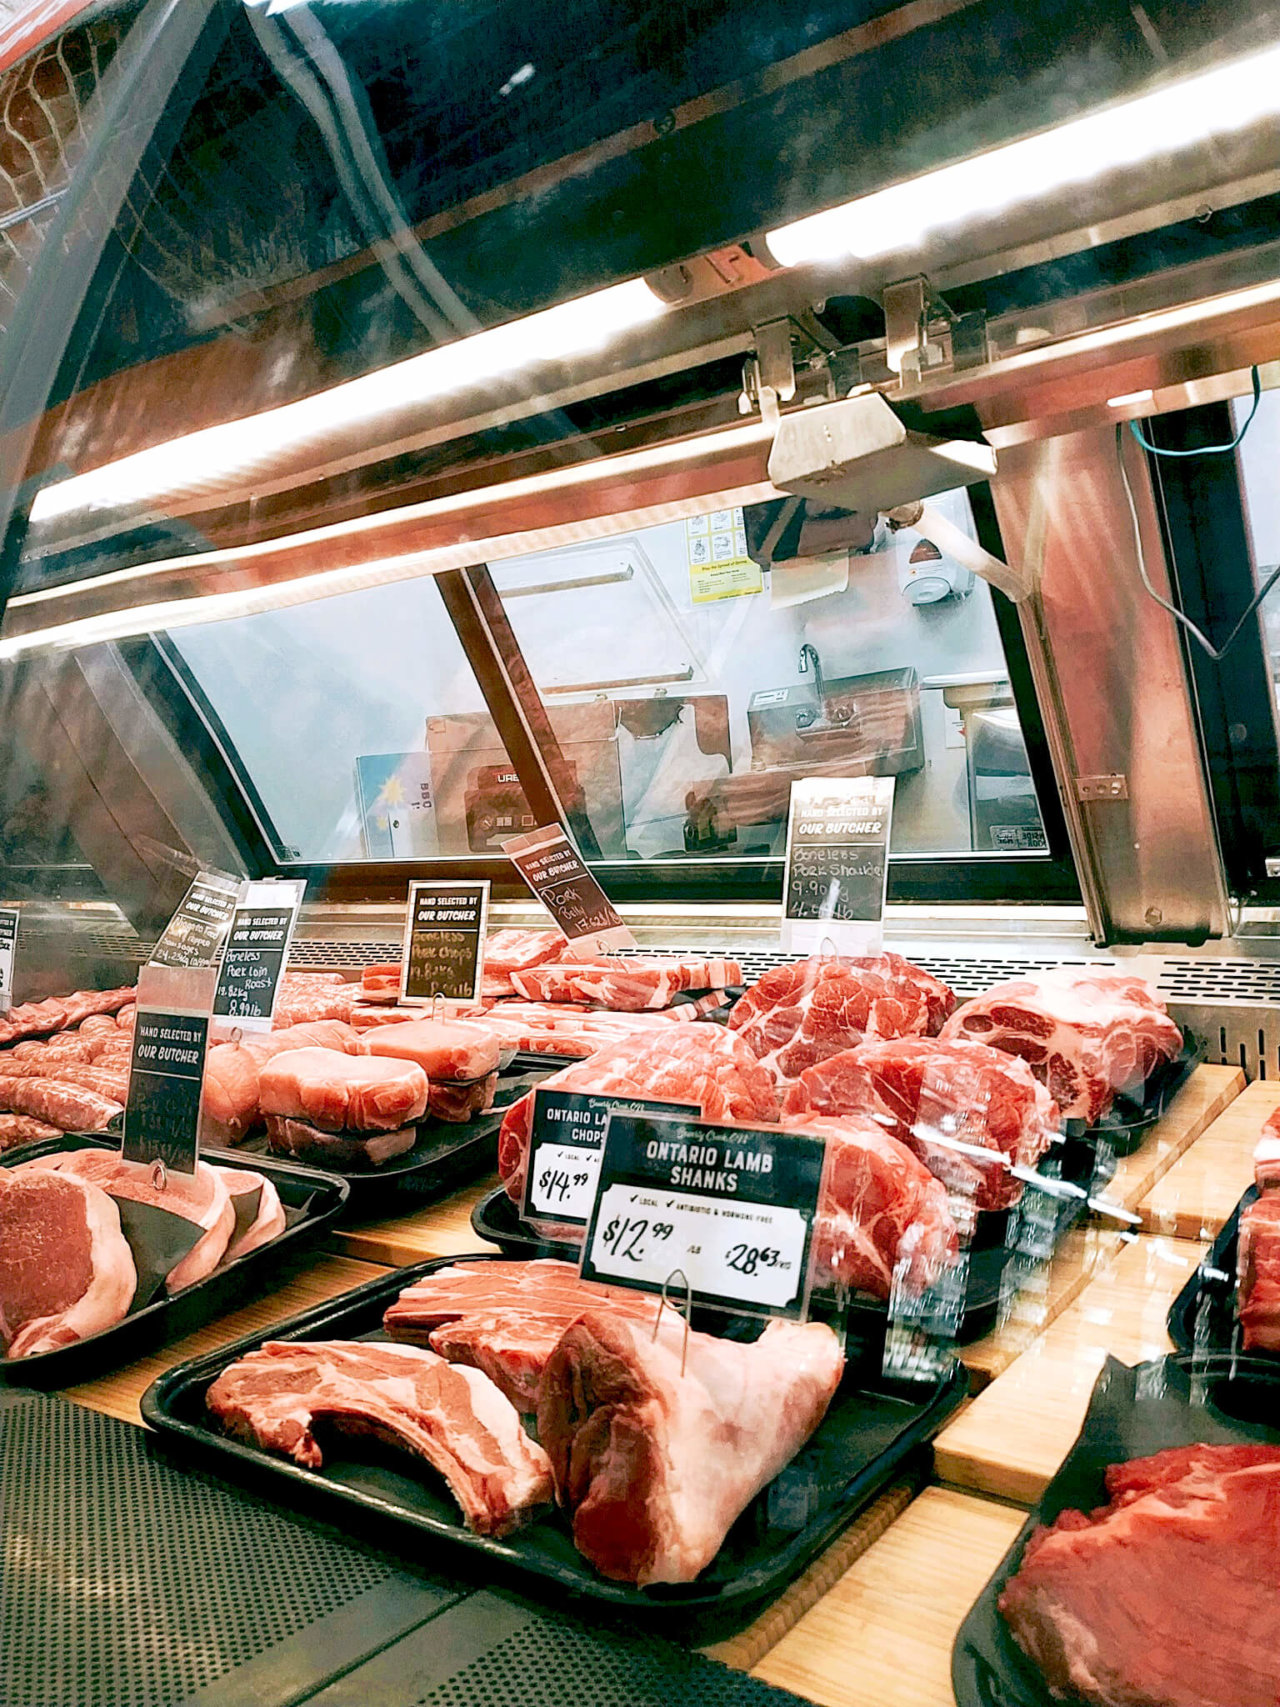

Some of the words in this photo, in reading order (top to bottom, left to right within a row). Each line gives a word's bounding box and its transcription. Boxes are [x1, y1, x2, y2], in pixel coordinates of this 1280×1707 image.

[799, 823, 824, 834] OUR
[825, 822, 882, 834] BUTCHER
[532, 871, 549, 882] OUR
[548, 860, 579, 877] BUTCHER
[420, 897, 436, 905] HAND
[437, 897, 468, 905] SELECTED
[469, 897, 478, 905] BY
[185, 901, 201, 912] OUR
[200, 905, 229, 920] BUTCHER
[418, 911, 435, 921] OUR
[436, 910, 476, 921] BUTCHER
[237, 918, 251, 926] HAND
[252, 918, 279, 926] SELECTED
[279, 917, 288, 925] BY
[233, 931, 250, 941] OUR
[249, 930, 284, 940] BUTCHER
[140, 1026, 158, 1038] HAND
[160, 1028, 192, 1042] SELECTED
[193, 1032, 202, 1043] BY
[138, 1044, 157, 1059] OUR
[158, 1047, 199, 1064] BUTCHER
[547, 1108, 591, 1124] ONTARIO
[594, 1112, 608, 1125] LA
[646, 1140, 718, 1166] ONTARIO
[723, 1148, 773, 1173] LAMB
[539, 1167, 589, 1202] $14.99
[670, 1165, 738, 1192] SHANKS
[639, 1198, 658, 1207] LOCAL
[602, 1214, 674, 1262] $12.99
